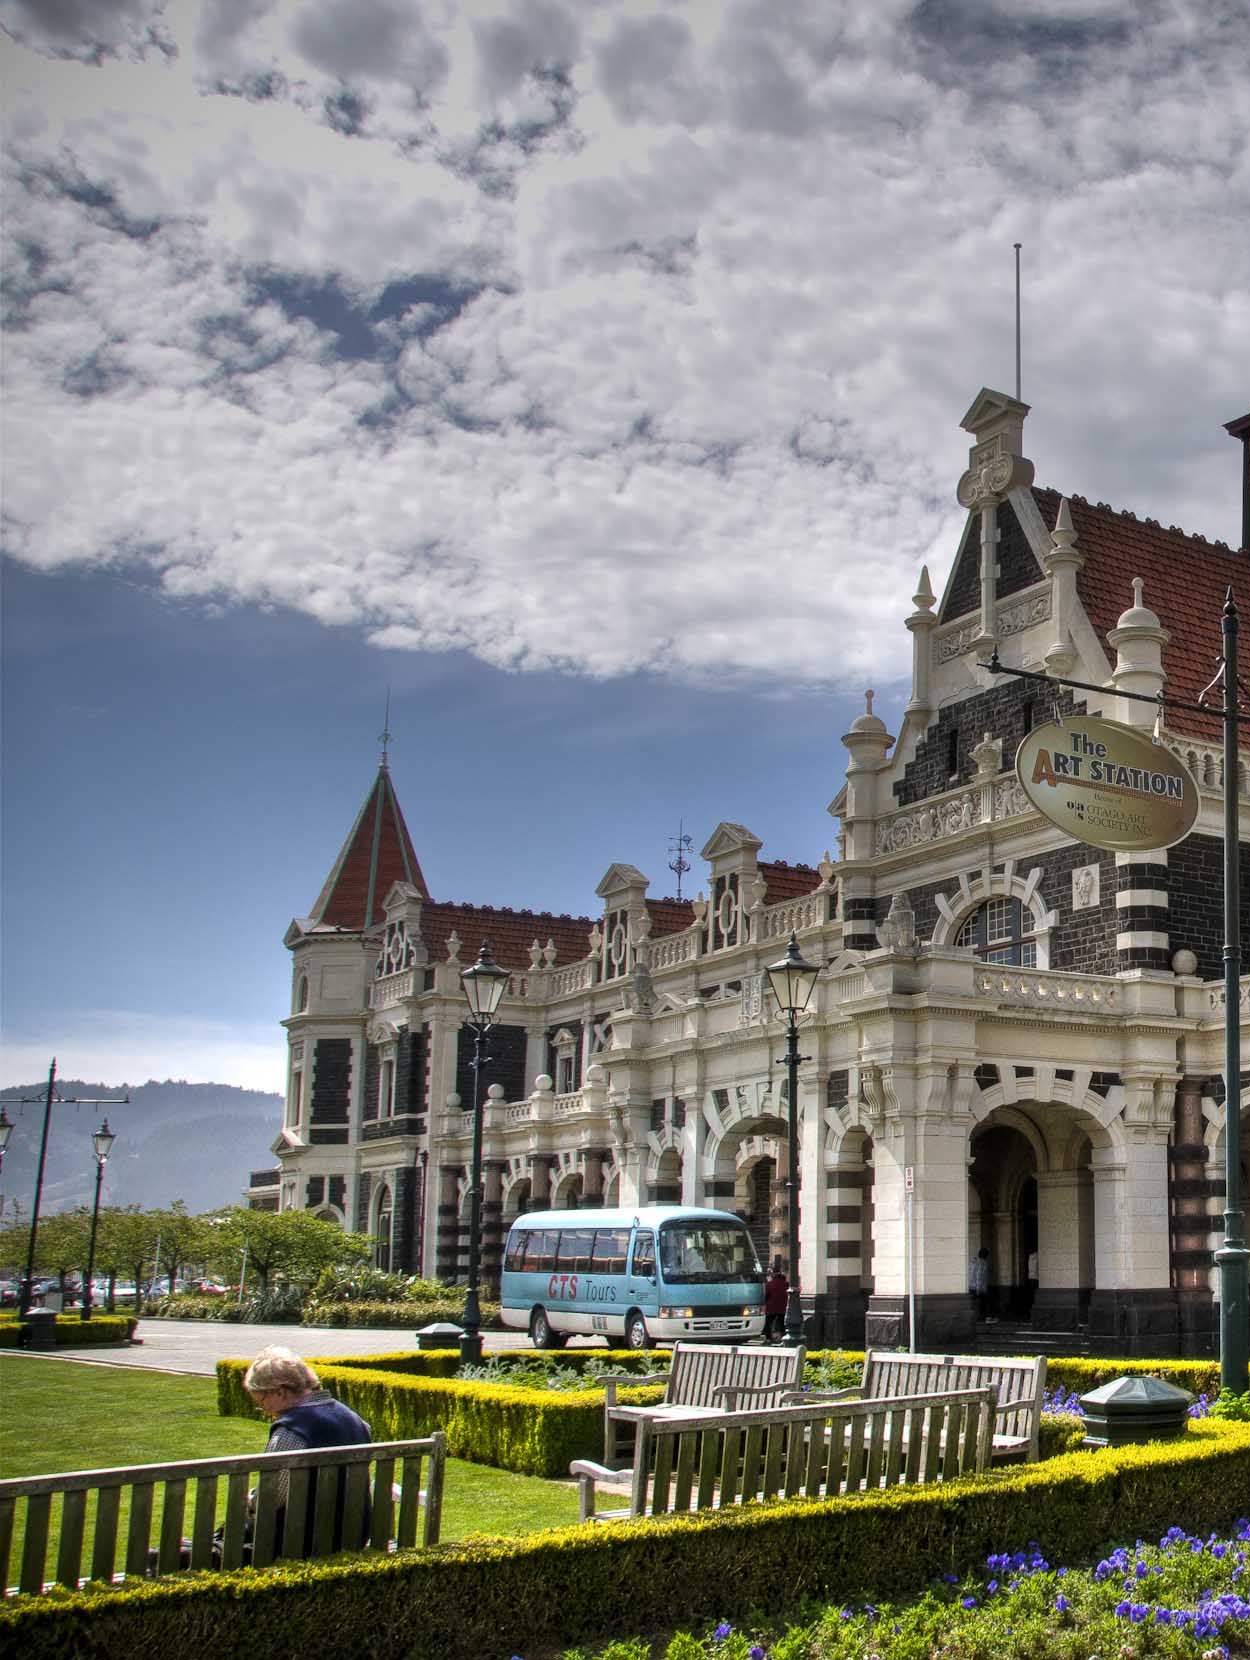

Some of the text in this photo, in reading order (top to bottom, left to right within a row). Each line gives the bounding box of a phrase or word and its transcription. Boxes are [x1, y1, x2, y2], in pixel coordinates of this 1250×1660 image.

[1070, 732, 1108, 758] The
[1032, 749, 1184, 800] ART STATION
[1086, 805, 1146, 825] OTAGO ART
[1087, 815, 1130, 833] SOCIETY
[548, 1274, 616, 1301] CTS Tours
